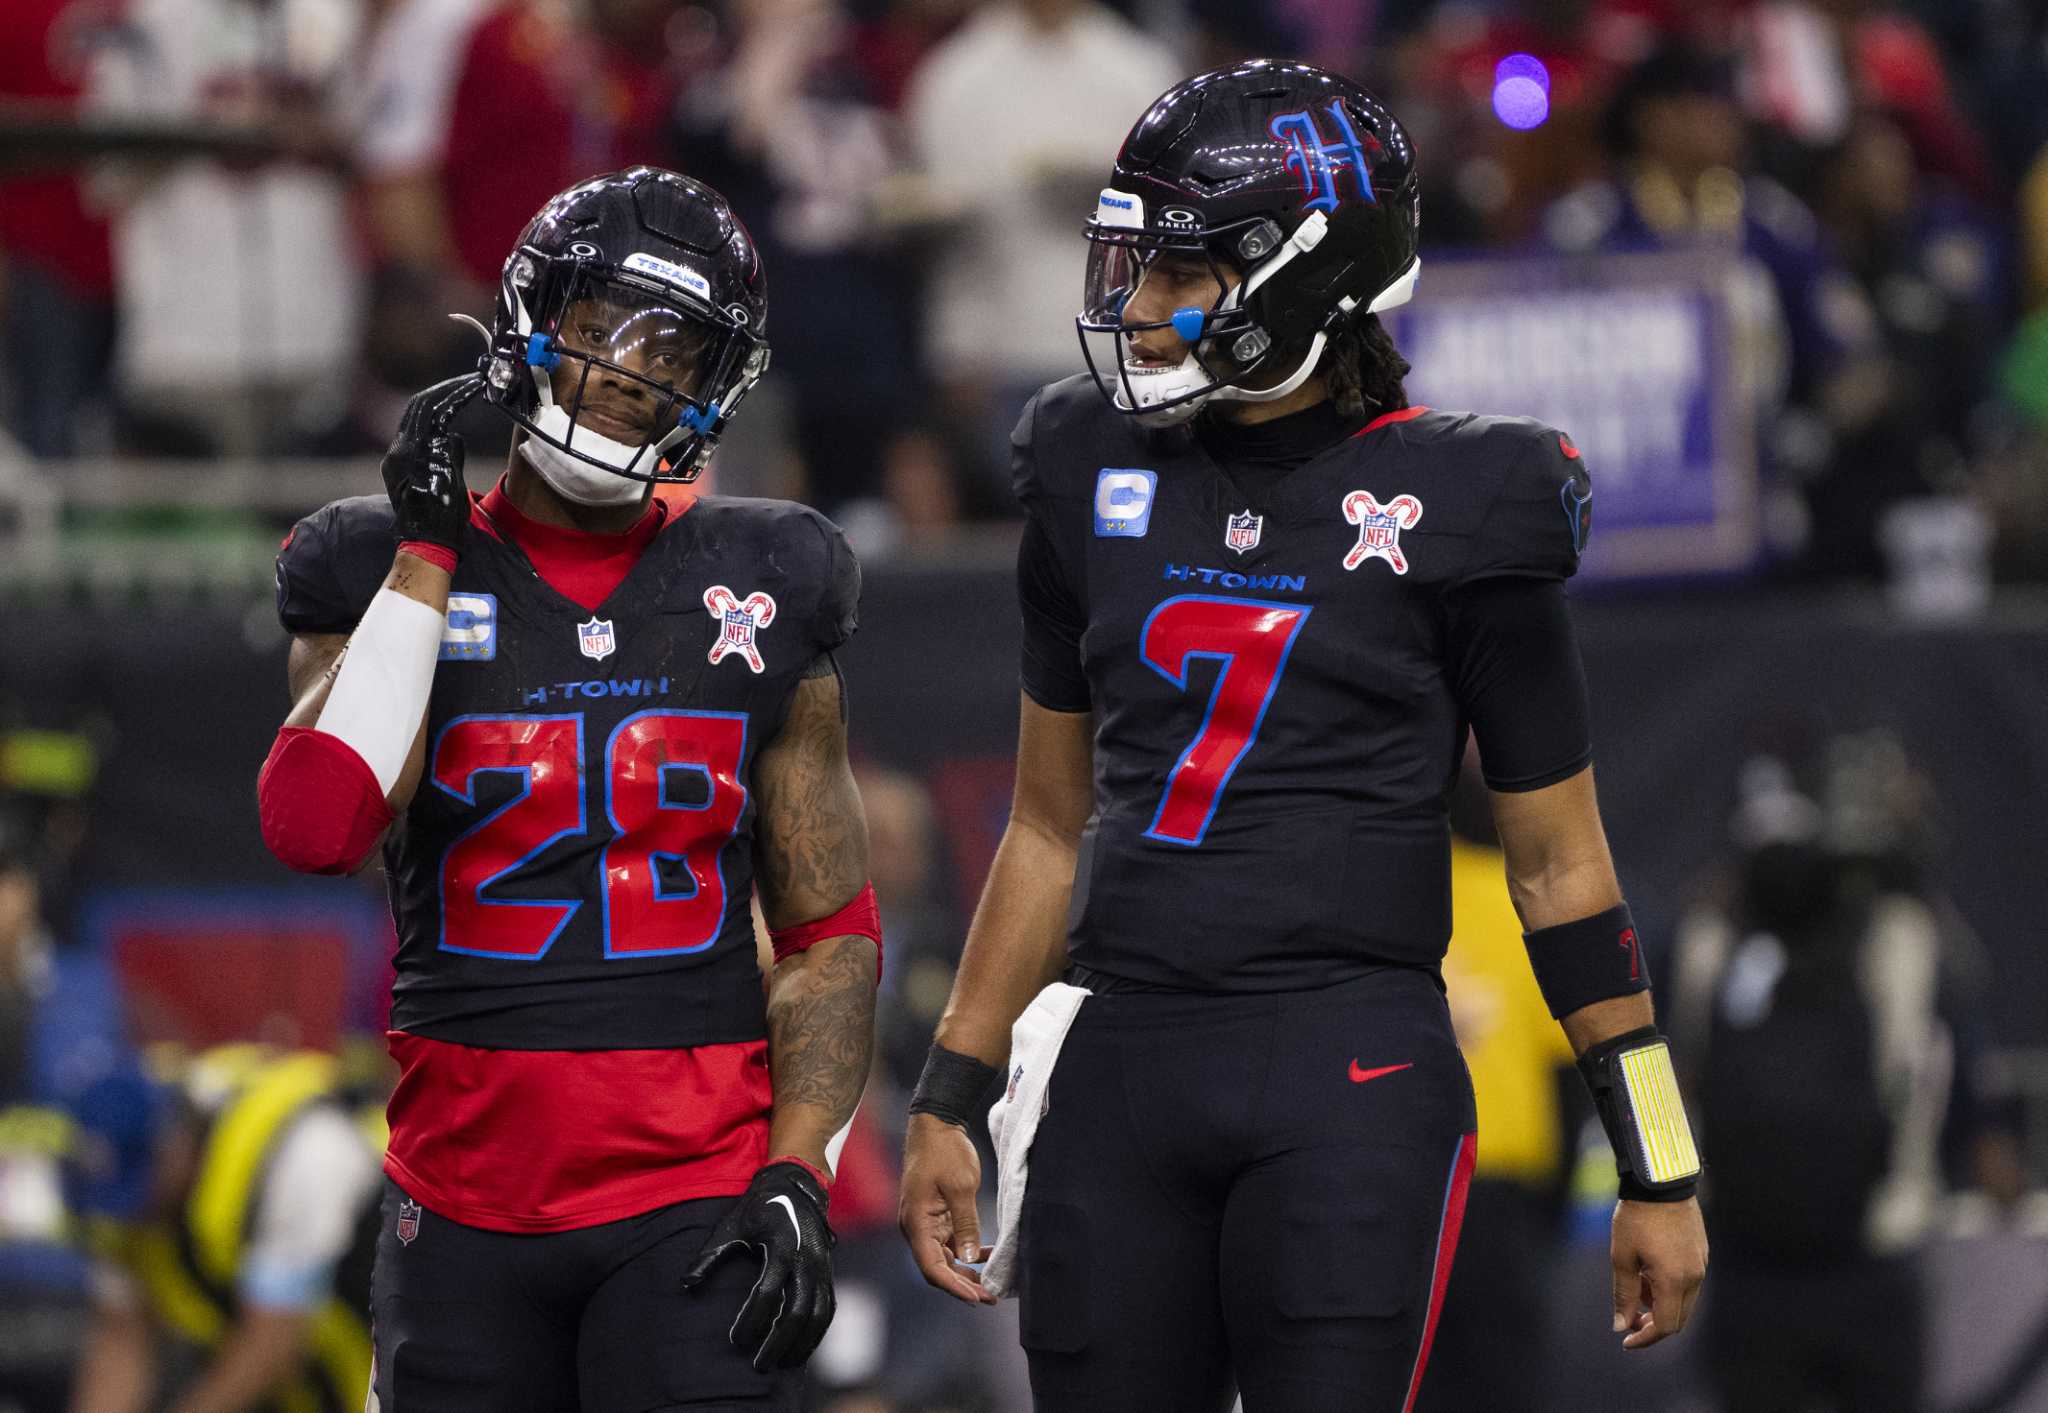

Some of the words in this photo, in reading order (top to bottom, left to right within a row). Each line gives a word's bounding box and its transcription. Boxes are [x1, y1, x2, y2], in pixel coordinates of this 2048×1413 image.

[1157, 220, 1202, 230] OAKLEY
[636, 257, 706, 290] TEXANS
[1098, 473, 1150, 519] C
[1231, 530, 1256, 546] NFL
[1366, 527, 1392, 546] NFL
[1163, 563, 1306, 591] H-TOWN
[584, 636, 610, 652] NFL
[727, 622, 751, 643] NFL
[522, 676, 669, 705] H-TOWN
[1140, 593, 1314, 847] 7
[430, 708, 749, 960] 28
[1618, 927, 1640, 982] 7
